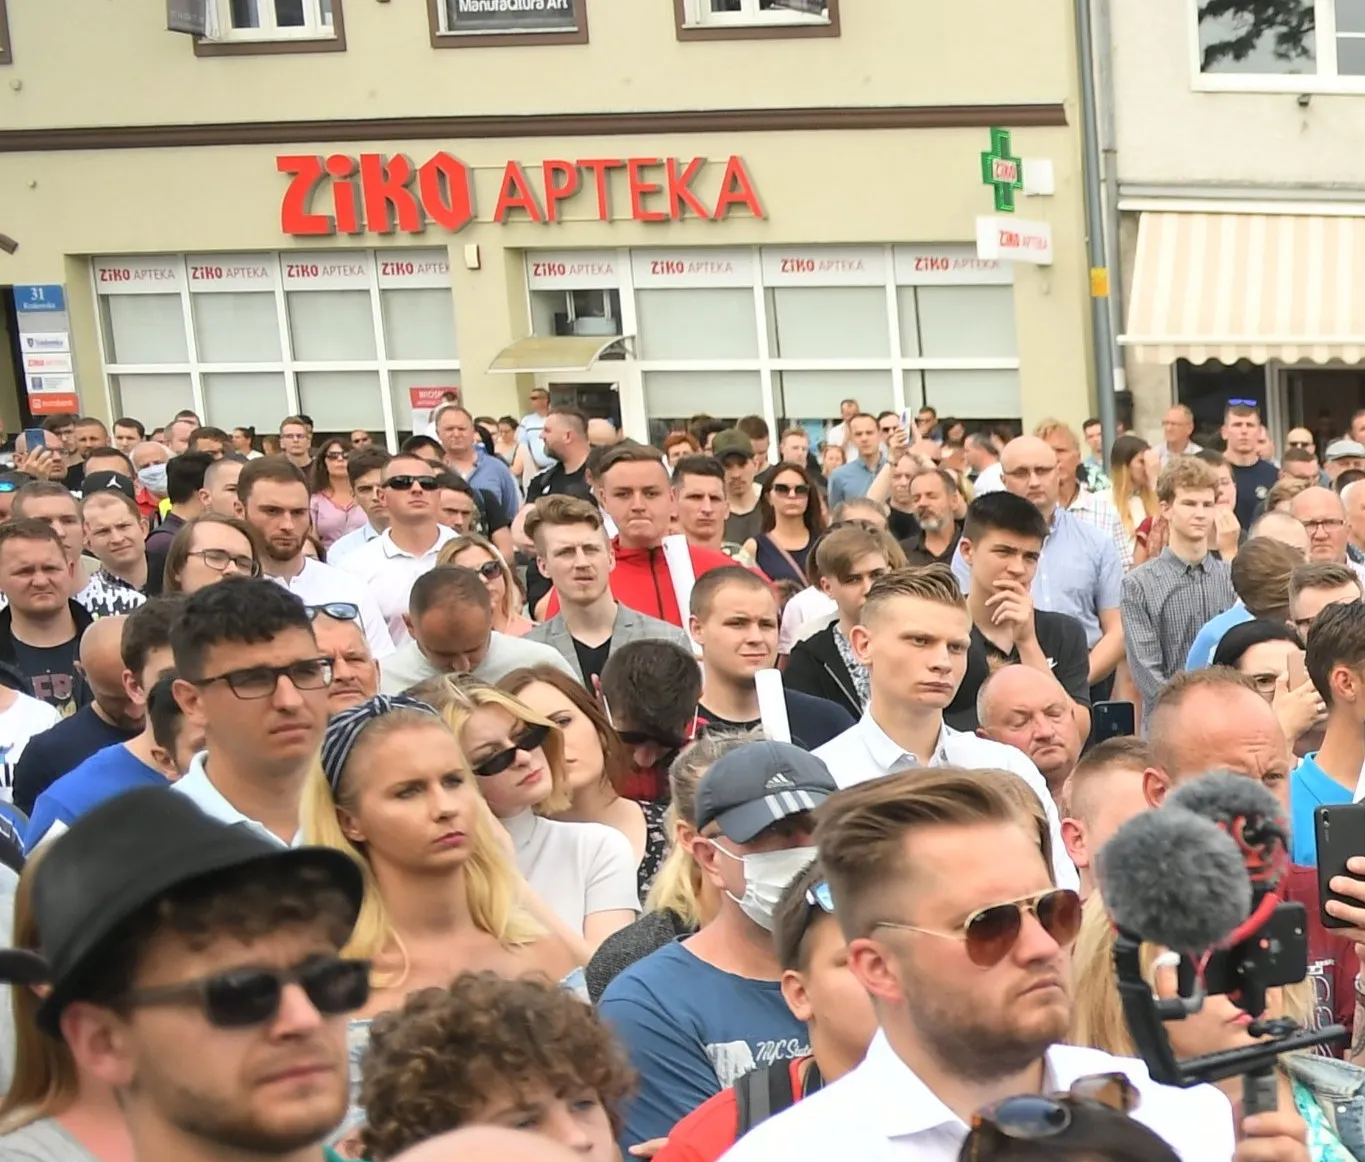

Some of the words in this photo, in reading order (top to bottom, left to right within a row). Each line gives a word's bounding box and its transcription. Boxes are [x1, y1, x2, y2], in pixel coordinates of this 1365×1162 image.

[493, 154, 767, 224] APTEKA
[321, 264, 366, 277] APTEKA
[568, 262, 614, 276] APTEKA
[687, 260, 734, 274] APTEKA
[818, 257, 865, 272] APTEKA
[952, 257, 1000, 271] APTEKA
[133, 267, 175, 281] APTEKA
[225, 266, 269, 279] APTEKA
[30, 287, 45, 302] 31
